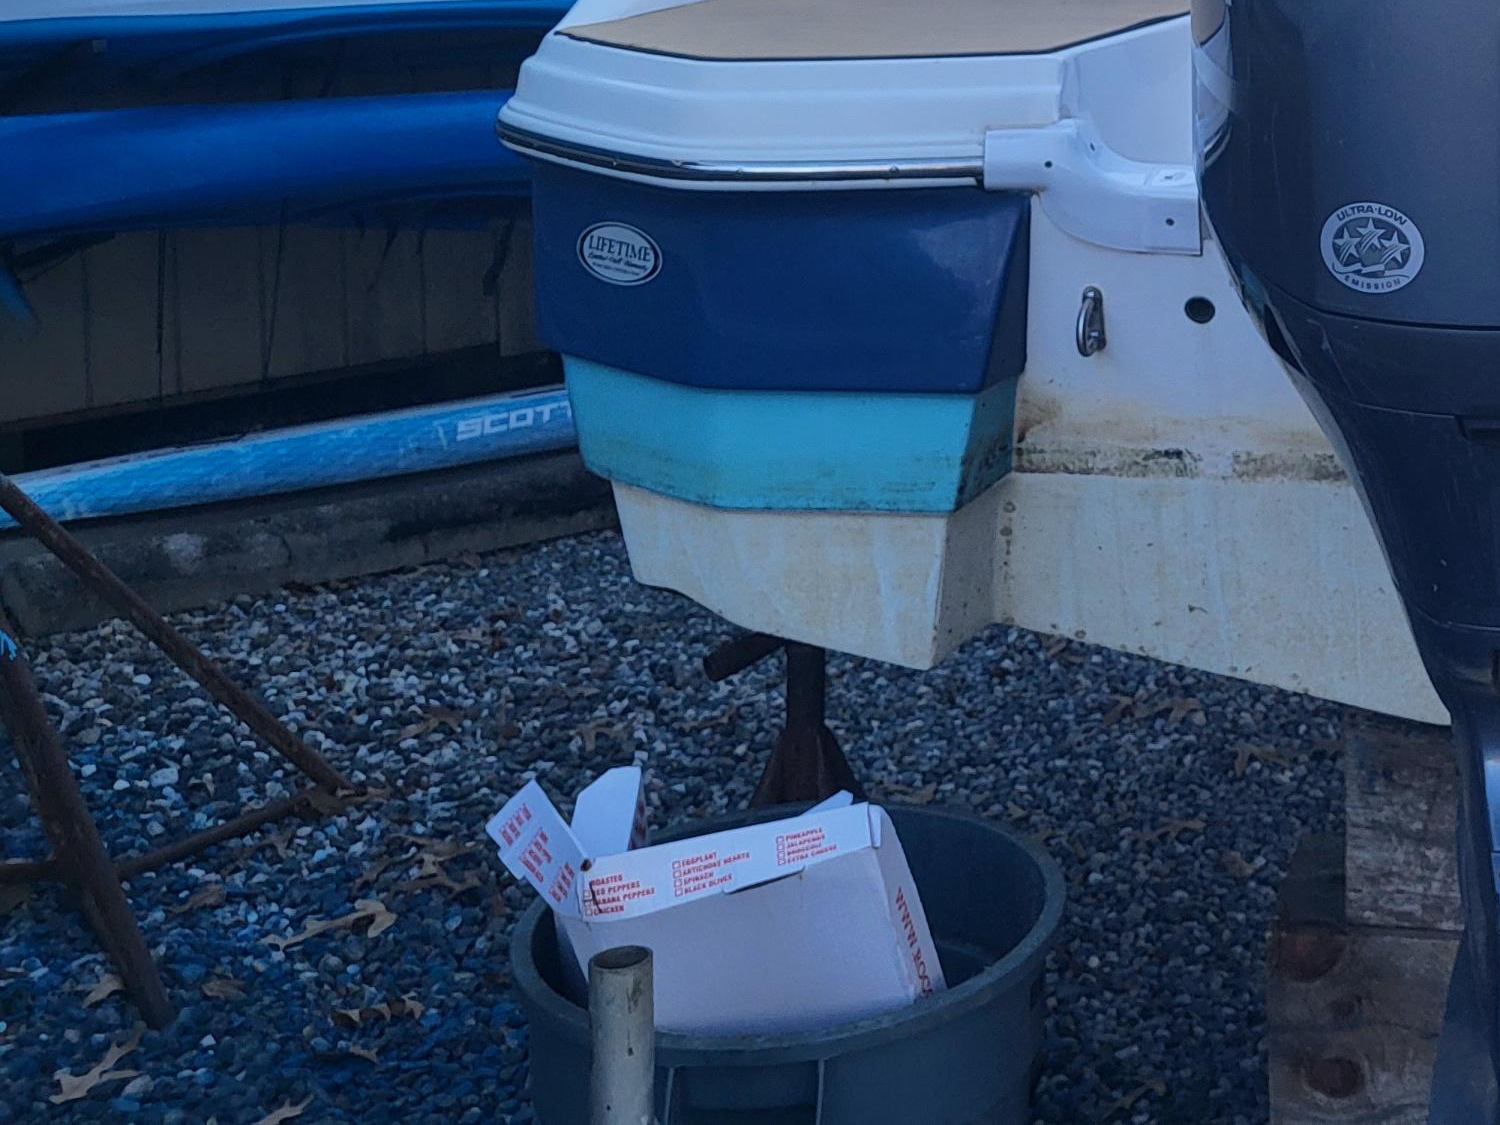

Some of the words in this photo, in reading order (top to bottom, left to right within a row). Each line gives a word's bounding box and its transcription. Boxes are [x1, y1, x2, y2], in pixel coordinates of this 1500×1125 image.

[589, 234, 651, 262] LIFETIME
[1344, 274, 1402, 290] EMISSION
[682, 852, 717, 867] EGGPLANT
[682, 861, 721, 876] ARTICHOKE
[723, 852, 750, 864] HEARTS
[591, 874, 623, 886] ROASTED
[684, 871, 714, 885] SPINACH
[684, 882, 707, 895] BLACK
[709, 873, 732, 887] OLIVES
[608, 880, 640, 894] PEPPERS
[623, 887, 656, 901] PEPPERS
